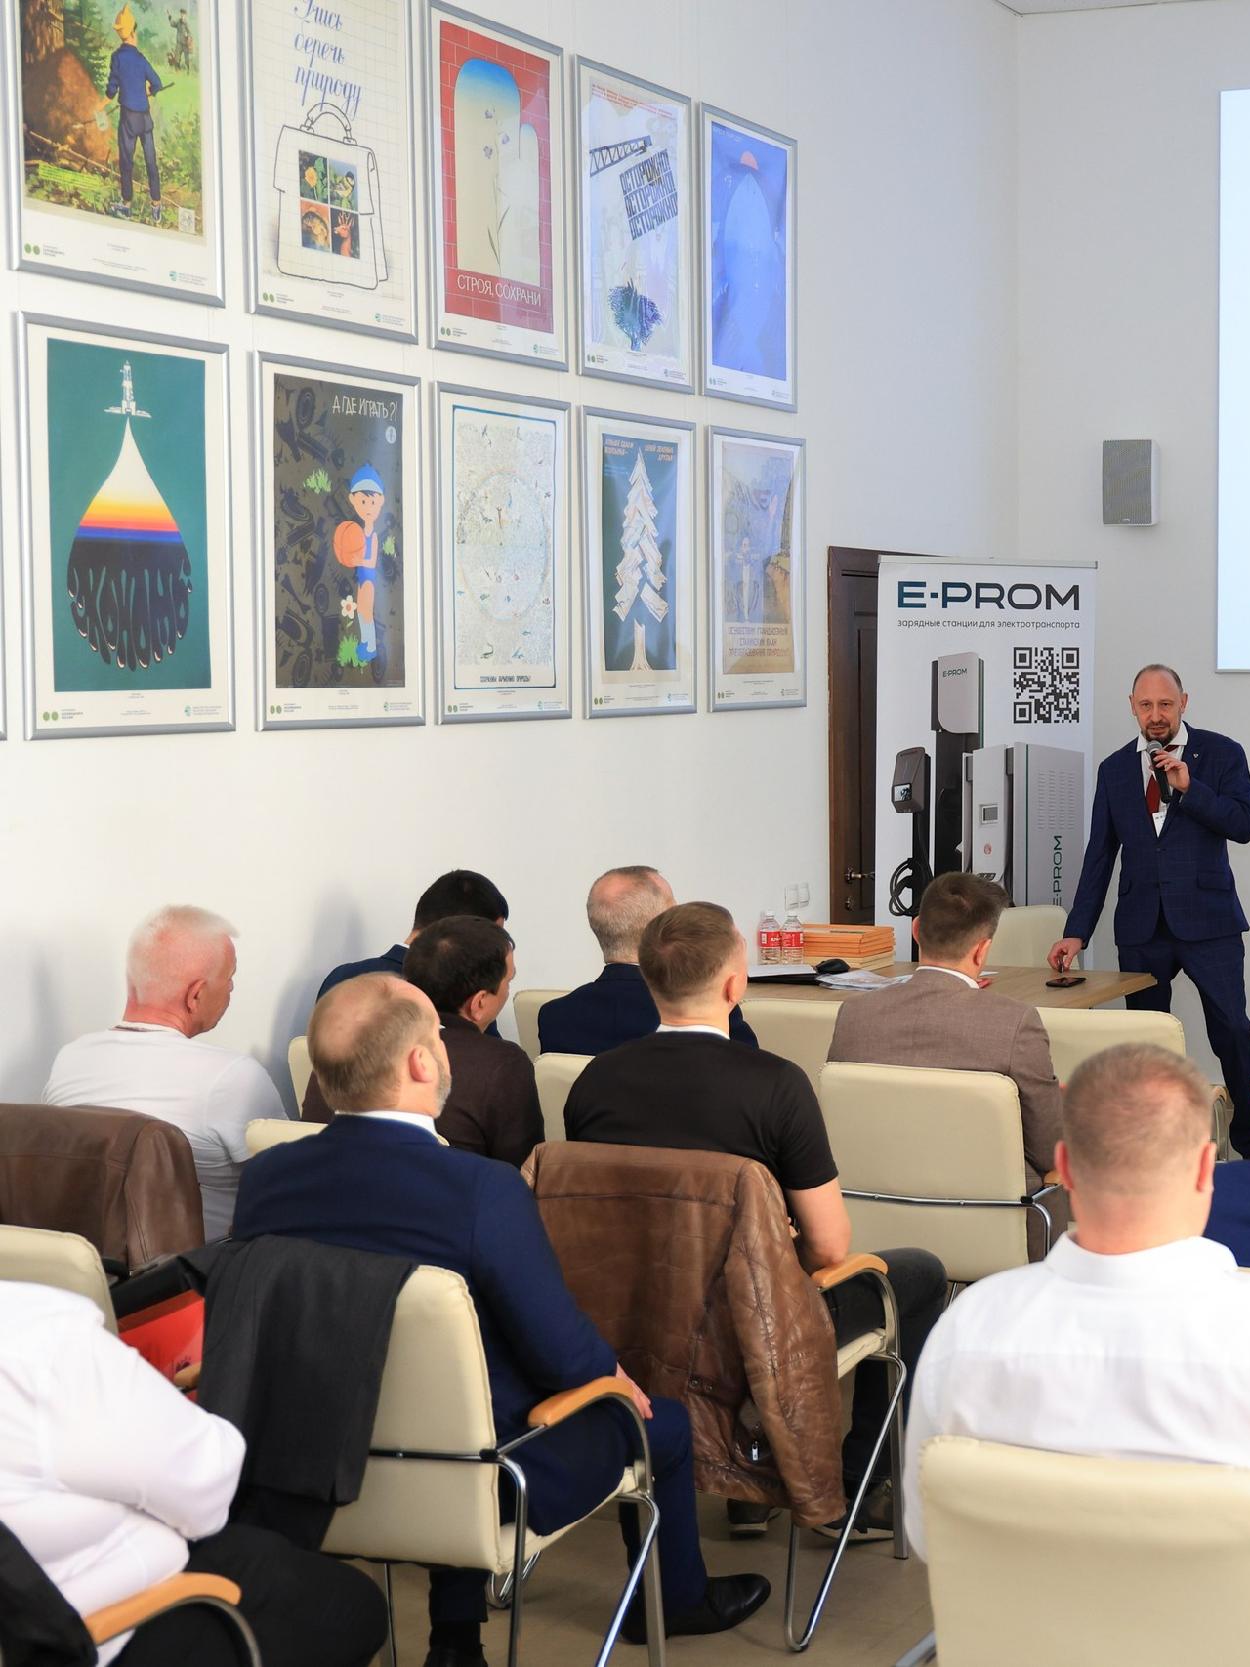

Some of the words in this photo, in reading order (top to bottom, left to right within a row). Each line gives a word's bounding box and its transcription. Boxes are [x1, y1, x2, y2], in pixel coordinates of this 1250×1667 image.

[295, 66, 361, 121] природу
[495, 282, 541, 307] СОХРАНИ
[332, 394, 341, 414] А
[342, 396, 357, 416] ГДЕ
[898, 581, 1080, 610] E-PROM
[897, 620, 940, 632] зарядные
[942, 620, 978, 630] станции
[979, 620, 995, 631] для
[997, 620, 1080, 631] электротранспорта
